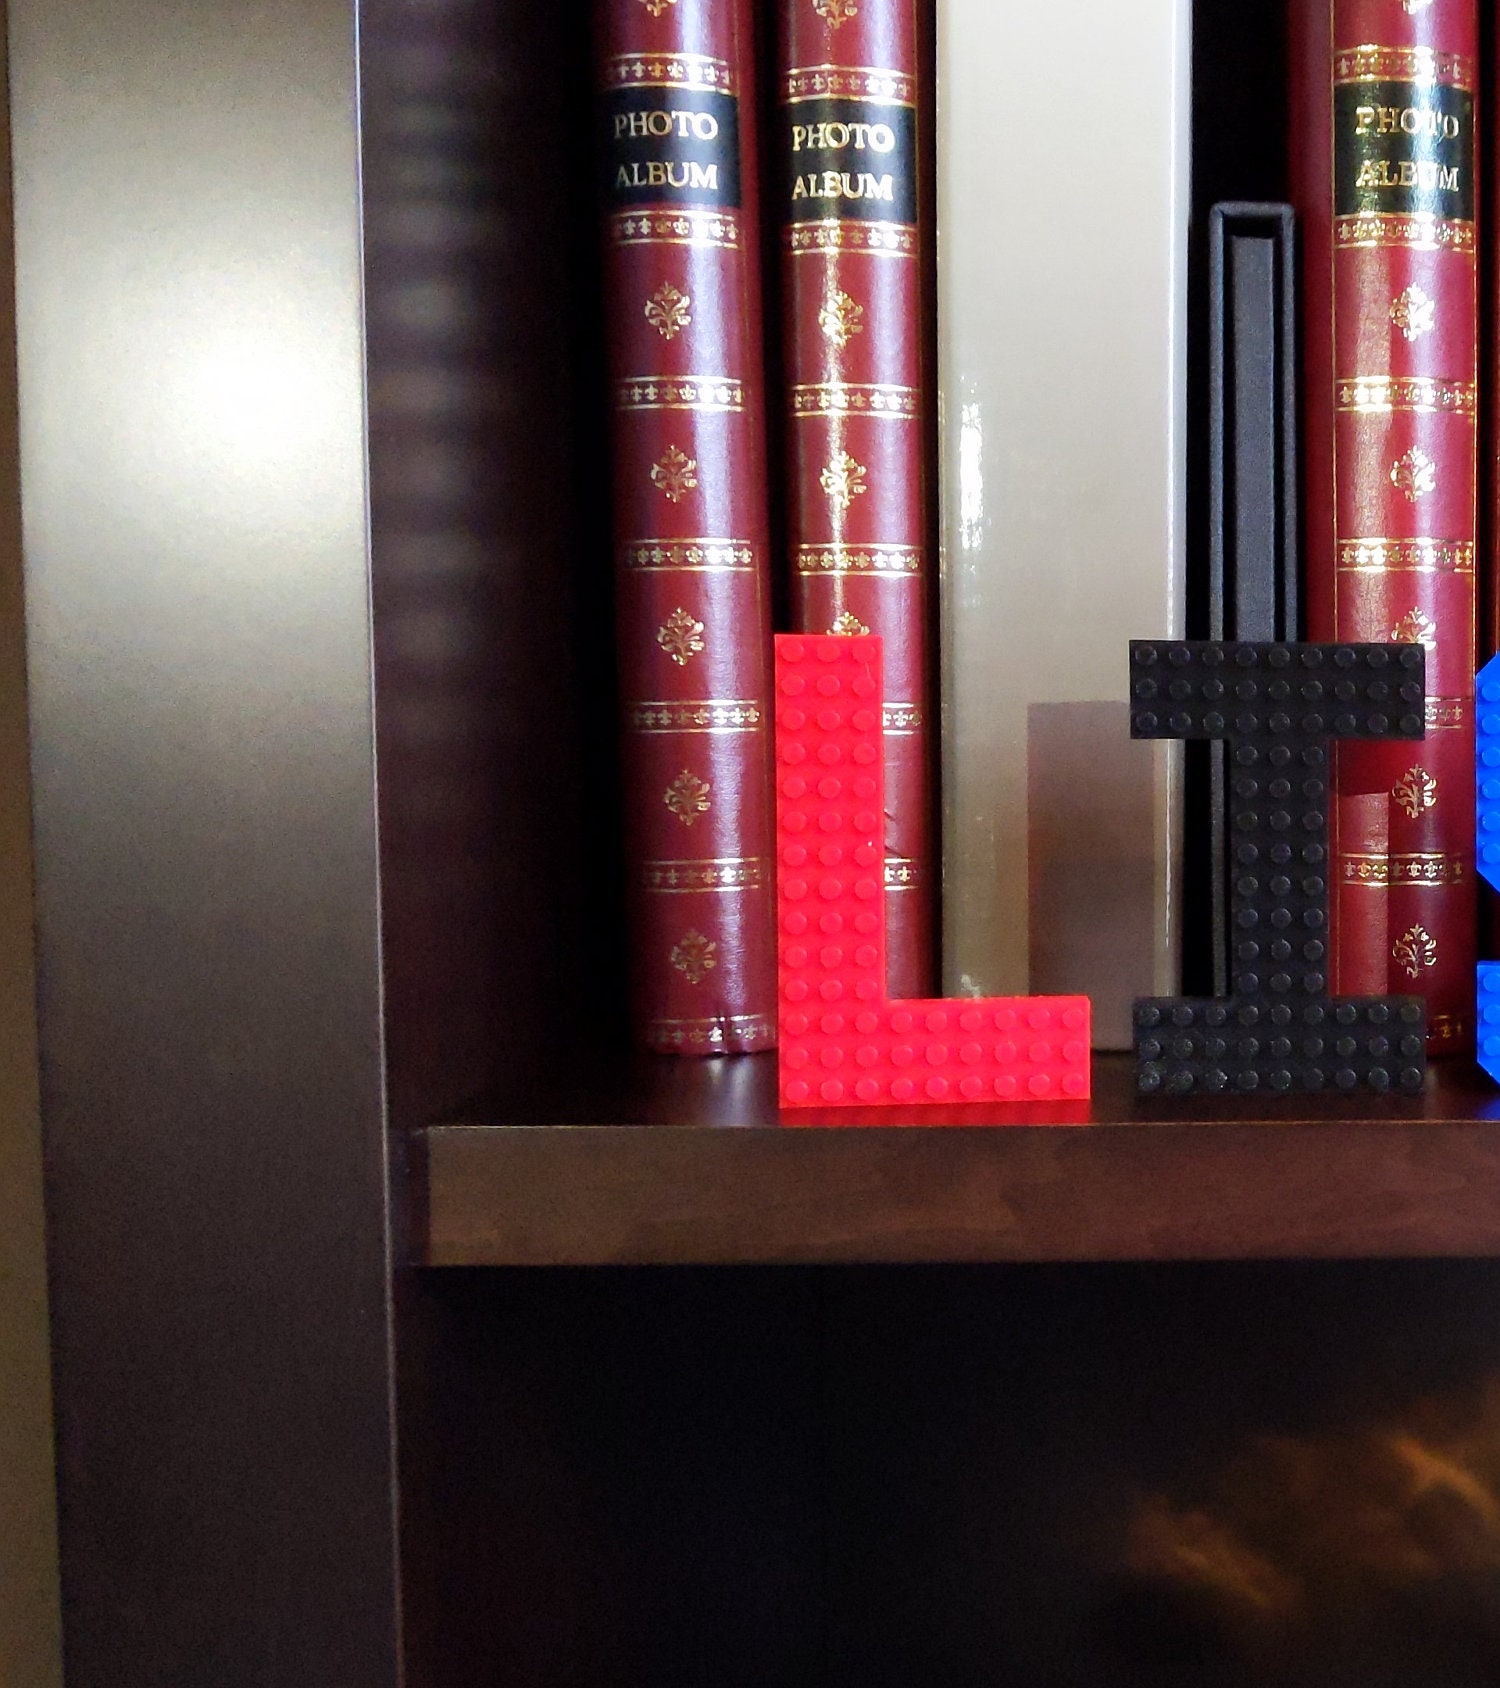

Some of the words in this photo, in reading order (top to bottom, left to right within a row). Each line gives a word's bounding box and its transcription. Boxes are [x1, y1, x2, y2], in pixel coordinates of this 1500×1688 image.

[614, 110, 718, 140] PHOTO
[1356, 105, 1459, 138] PHOTO
[792, 122, 895, 152] PHOTO
[615, 161, 718, 190] ALBUM
[791, 170, 894, 200] ALBUM
[1355, 159, 1460, 192] ALBUM
